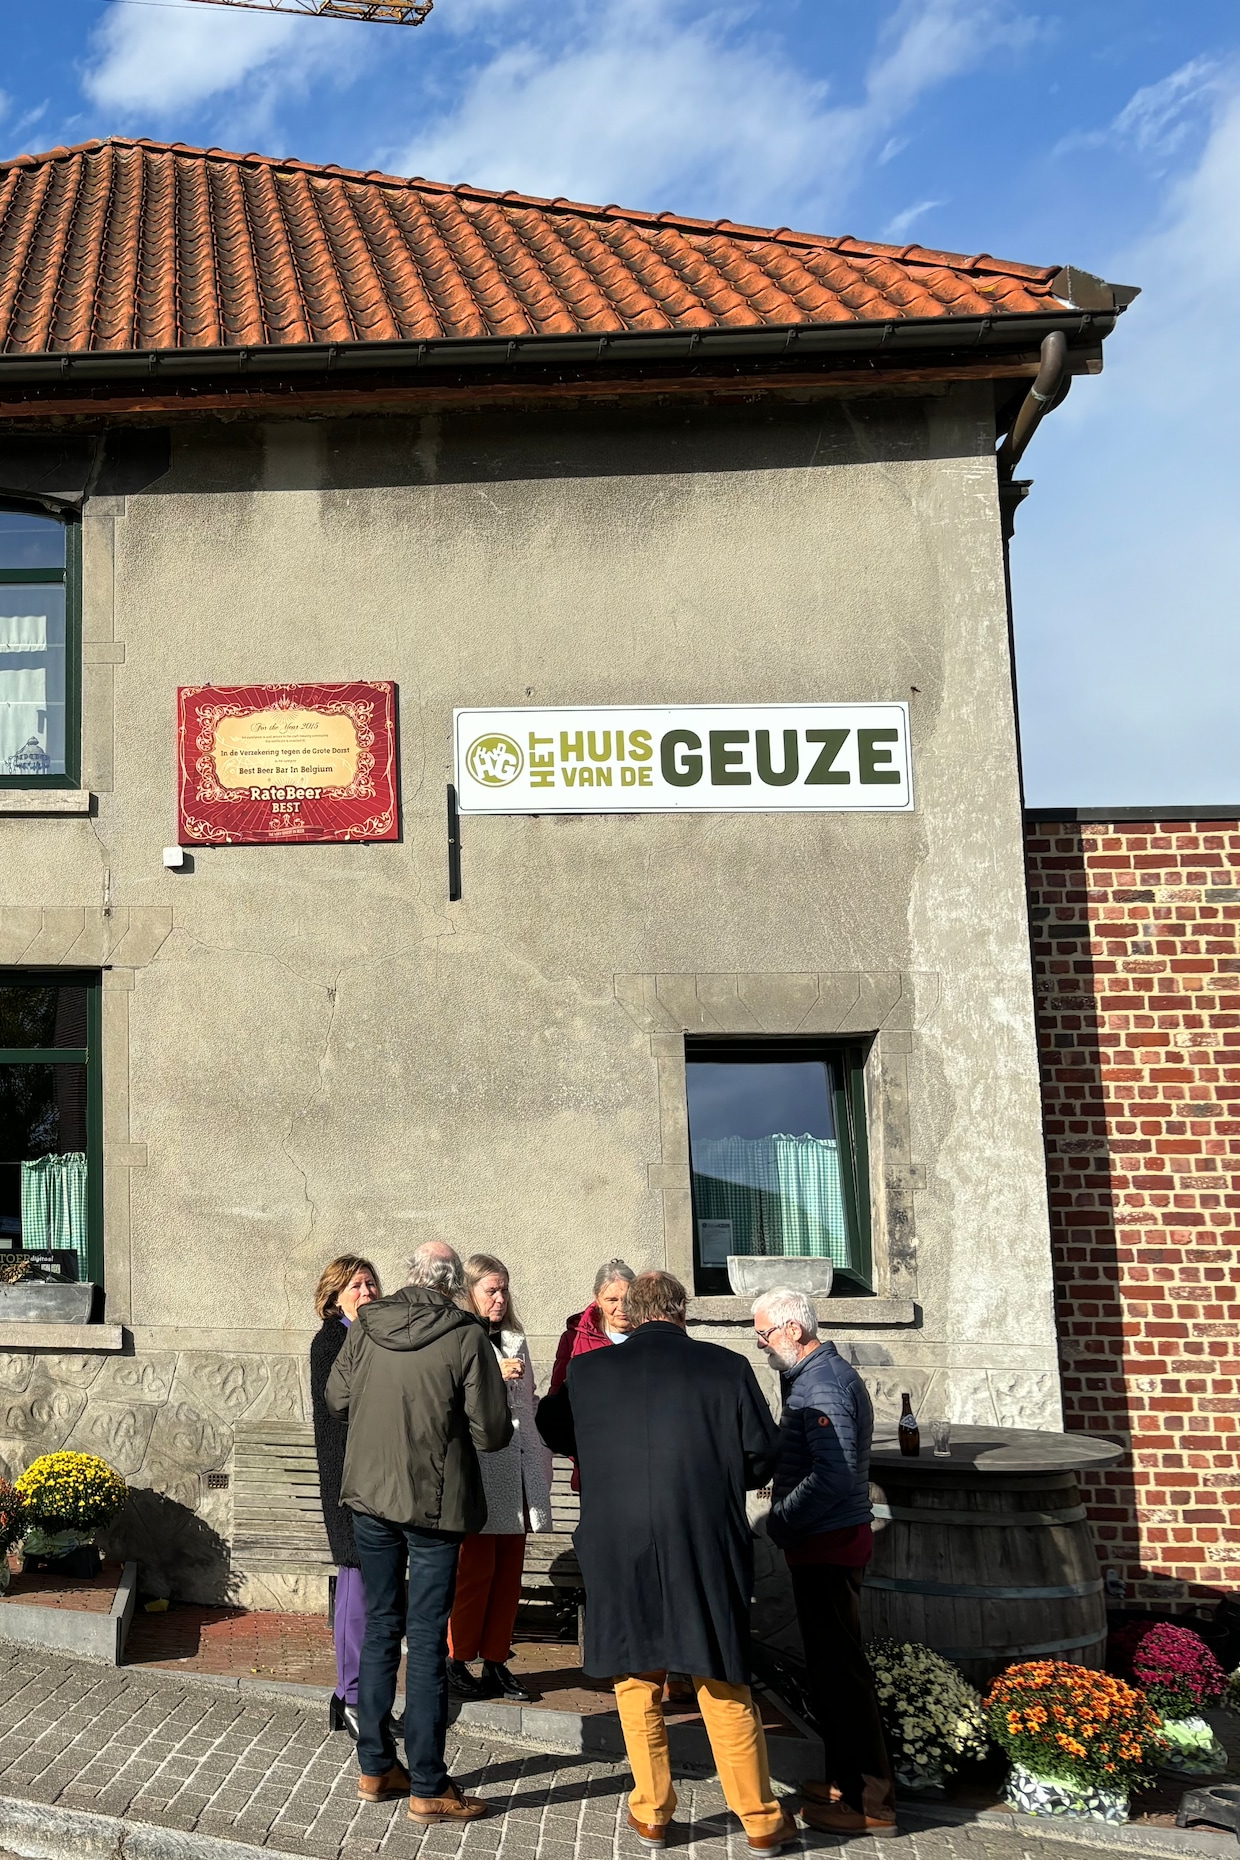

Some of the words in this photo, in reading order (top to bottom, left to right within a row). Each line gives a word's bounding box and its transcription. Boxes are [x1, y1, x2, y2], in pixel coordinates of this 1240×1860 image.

[300, 722, 319, 731] 2015
[229, 749, 239, 757] de
[239, 748, 280, 758] Verzekering
[281, 748, 301, 757] tegen
[302, 747, 311, 755] de
[312, 747, 331, 755] Grote
[560, 729, 653, 762] HUIS
[529, 731, 555, 788] HET
[659, 728, 901, 787] GEUZE
[239, 766, 255, 775] Best
[257, 766, 273, 775] Beer
[275, 766, 288, 774] Bar
[301, 764, 333, 774] Belgium
[565, 767, 615, 787] VAN
[621, 766, 653, 786] DE
[250, 786, 322, 801] RateBeer
[272, 802, 300, 813] BEST
